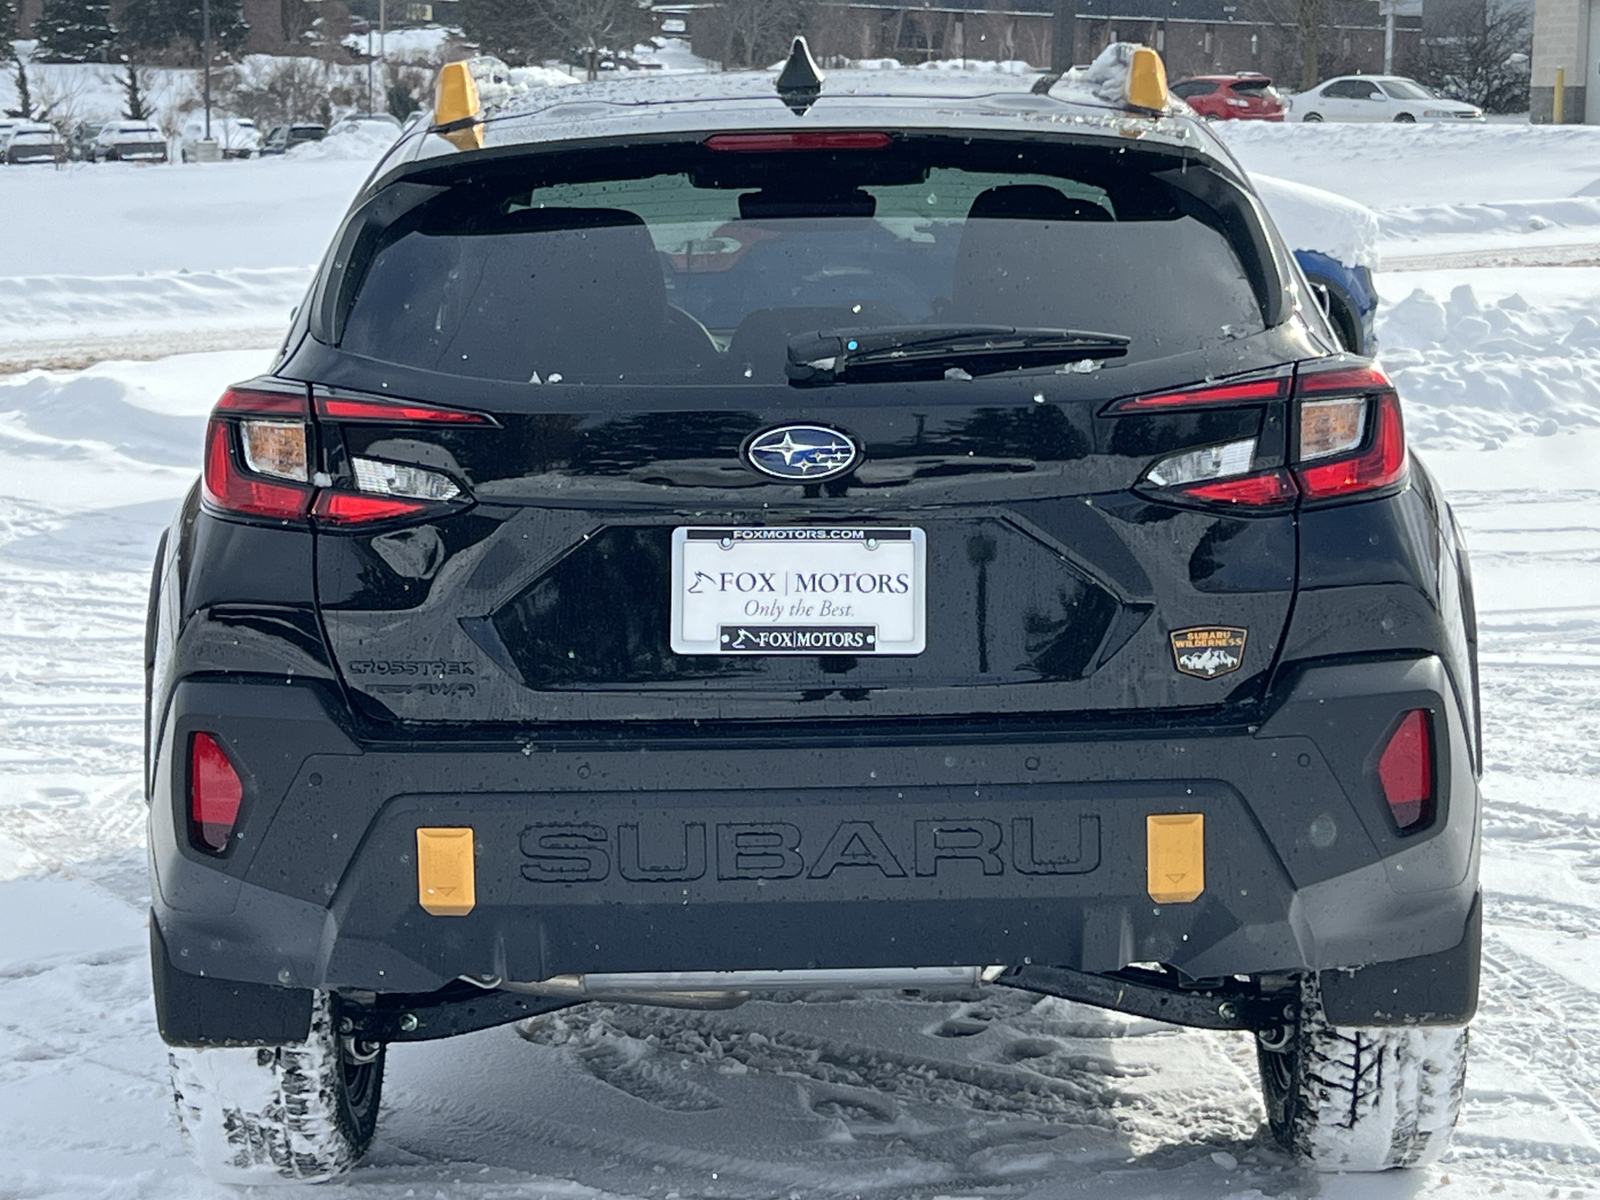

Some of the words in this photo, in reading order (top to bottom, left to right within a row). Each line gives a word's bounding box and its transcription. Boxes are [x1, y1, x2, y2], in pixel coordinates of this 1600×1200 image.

[733, 530, 864, 539] FOXMOTORS.COM
[719, 572, 776, 592] FOX
[795, 572, 909, 594] MOTORS
[744, 599, 784, 622] Only
[789, 600, 814, 617] the
[819, 600, 855, 617] Best.
[1175, 638, 1242, 648] WILDERNESS
[1187, 631, 1231, 640] SUBARU
[349, 660, 475, 676] CROSSTREK
[519, 814, 1103, 883] SUBARU
